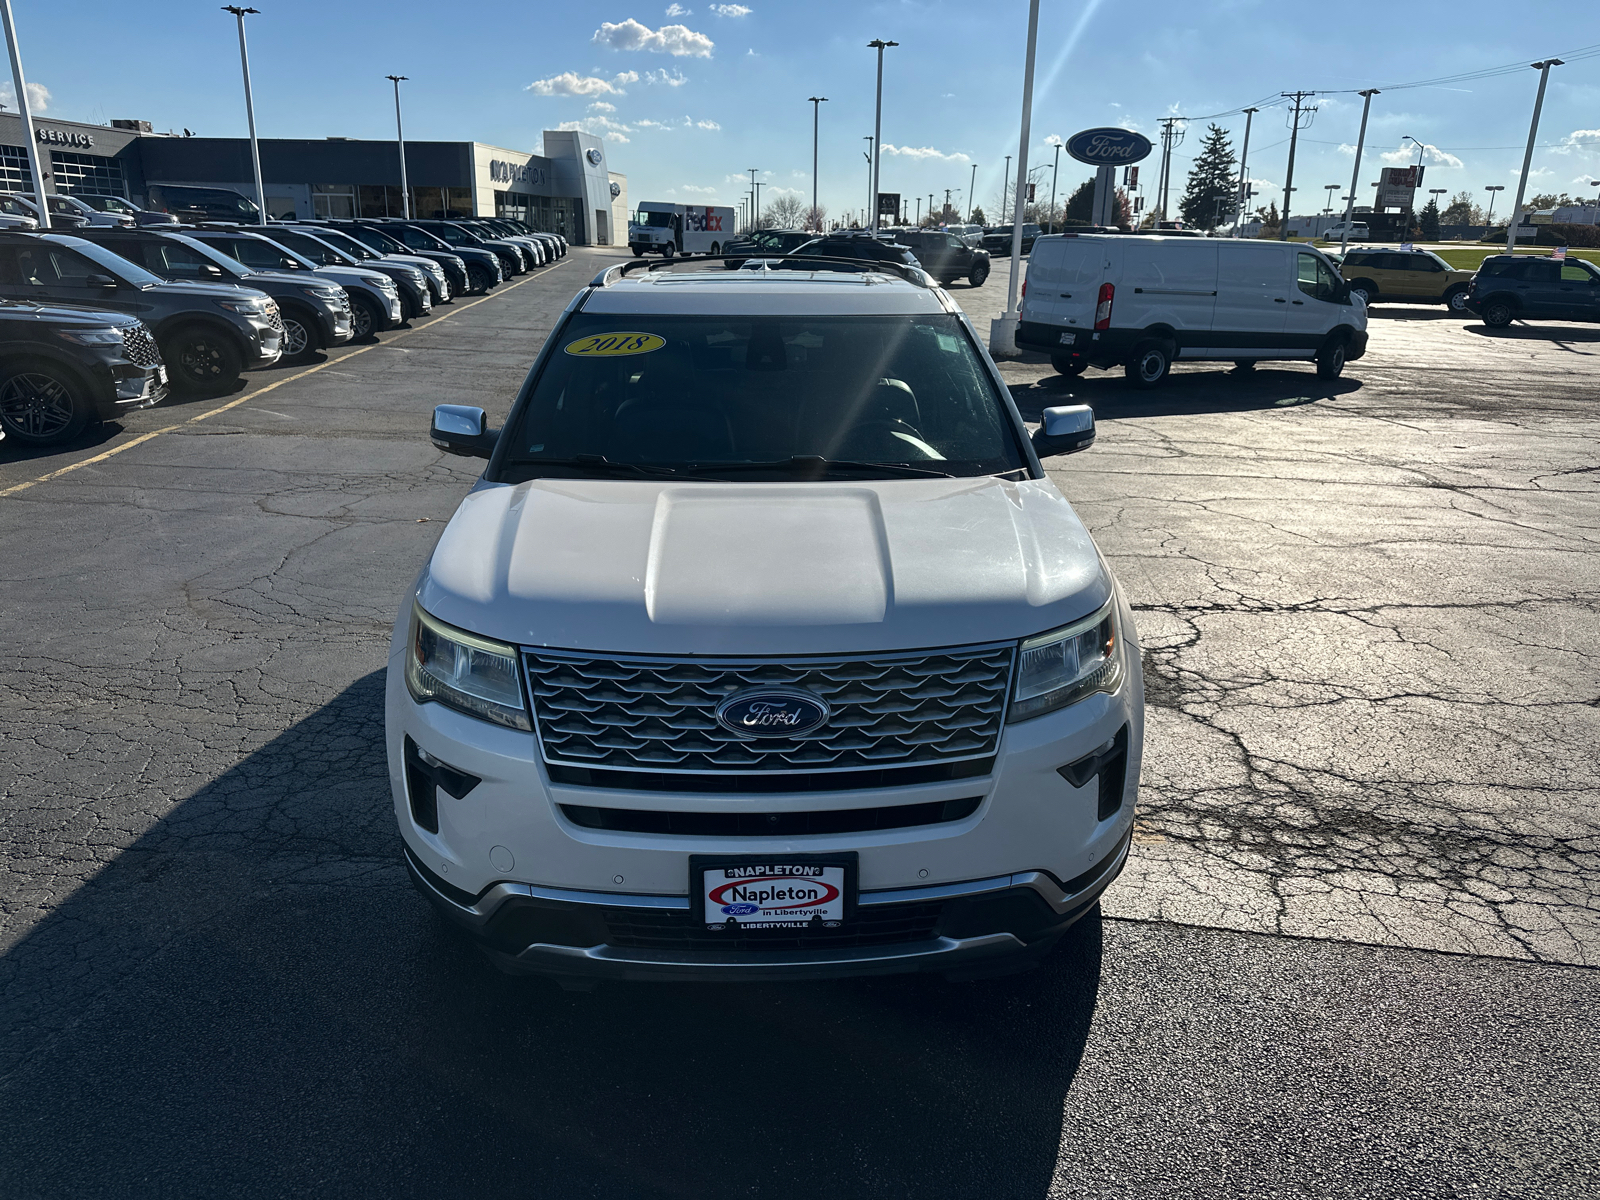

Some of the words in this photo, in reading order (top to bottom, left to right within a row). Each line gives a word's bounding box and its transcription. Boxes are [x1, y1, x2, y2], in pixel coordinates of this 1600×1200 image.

[40, 129, 95, 146] SERVICE
[1086, 135, 1135, 157] Ford
[491, 160, 546, 186] NAPLETON
[686, 206, 722, 231] FedEx
[578, 336, 650, 353] 2018
[743, 701, 802, 726] Ford
[734, 865, 815, 878] NAPLETON
[732, 886, 818, 904] Napleton
[729, 905, 752, 914] Ford
[774, 909, 828, 917] Libertyville
[741, 922, 809, 930] LIBERTYVILLE
